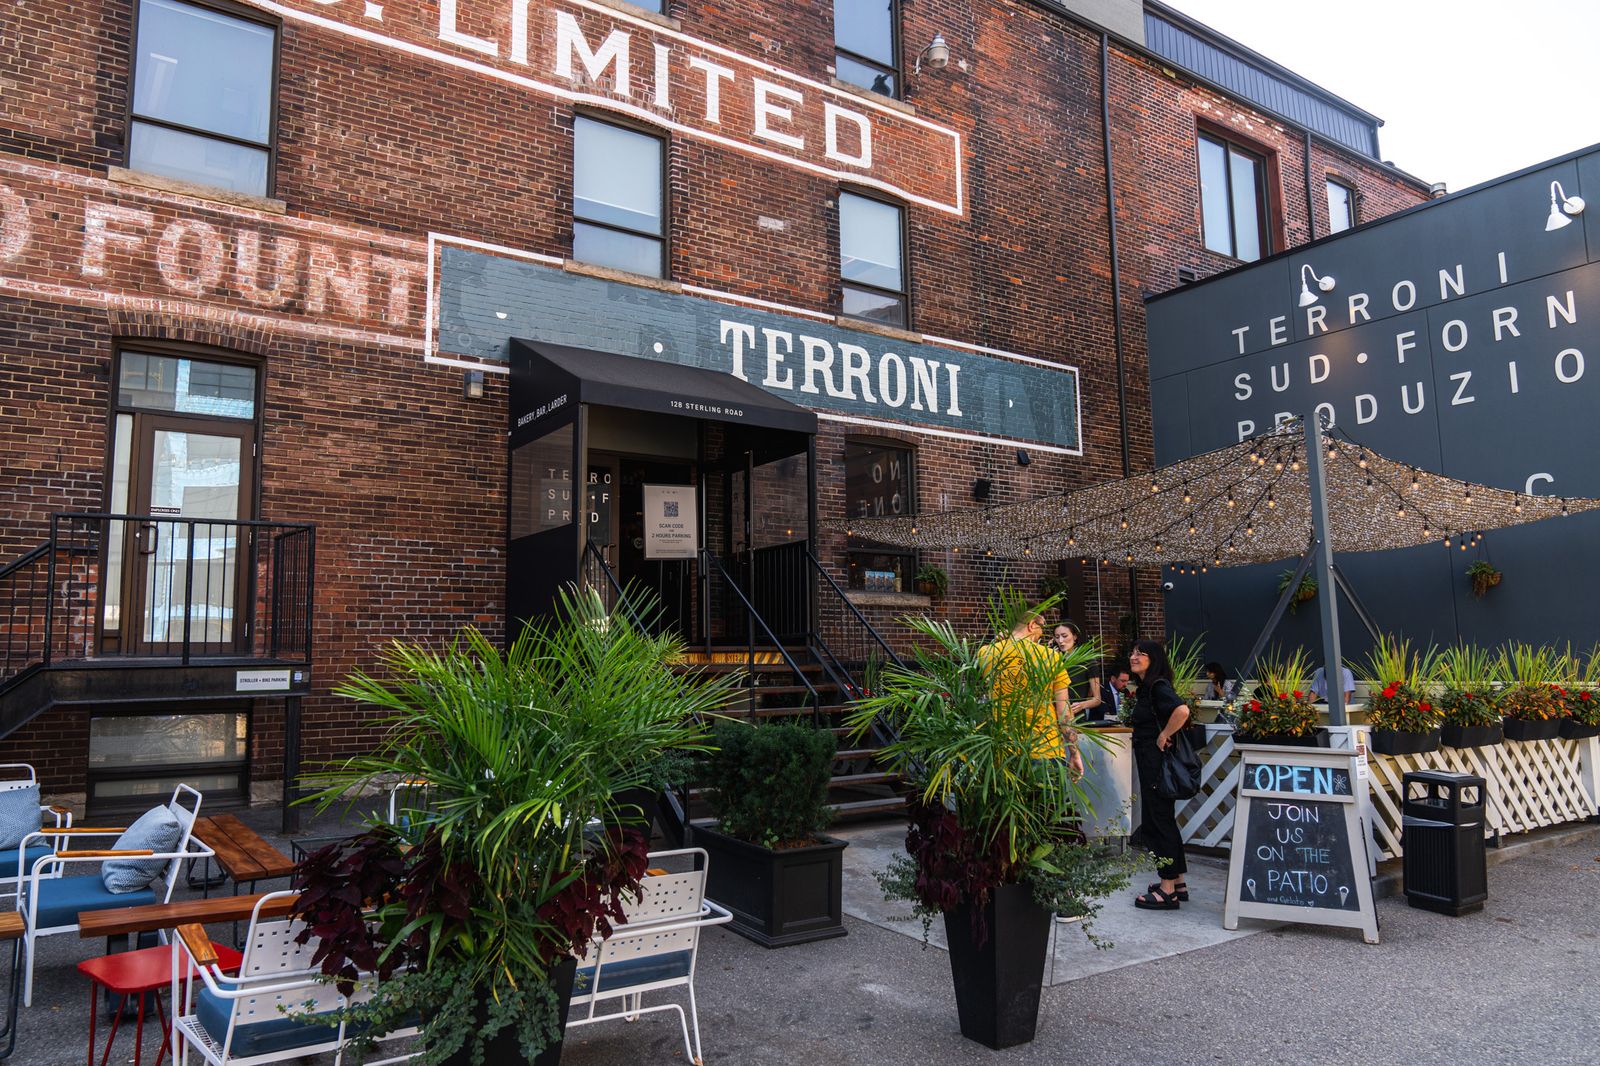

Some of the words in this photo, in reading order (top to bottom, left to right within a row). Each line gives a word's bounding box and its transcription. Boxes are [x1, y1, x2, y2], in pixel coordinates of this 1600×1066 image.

[437, 0, 873, 169] LIMITED
[1231, 251, 1508, 354] TERRONI
[1234, 354, 1331, 401] SUD
[1396, 290, 1578, 364] FORN
[719, 319, 963, 417] TERRONI
[670, 400, 683, 408] 128
[685, 402, 721, 414] STERLING
[724, 408, 743, 417] ROAD
[1254, 764, 1334, 795] OPEN
[1267, 802, 1319, 823] JOIN
[1276, 827, 1304, 844] US
[1257, 845, 1284, 861] ON
[1296, 847, 1330, 864] THE
[1267, 869, 1328, 894] PATIO
